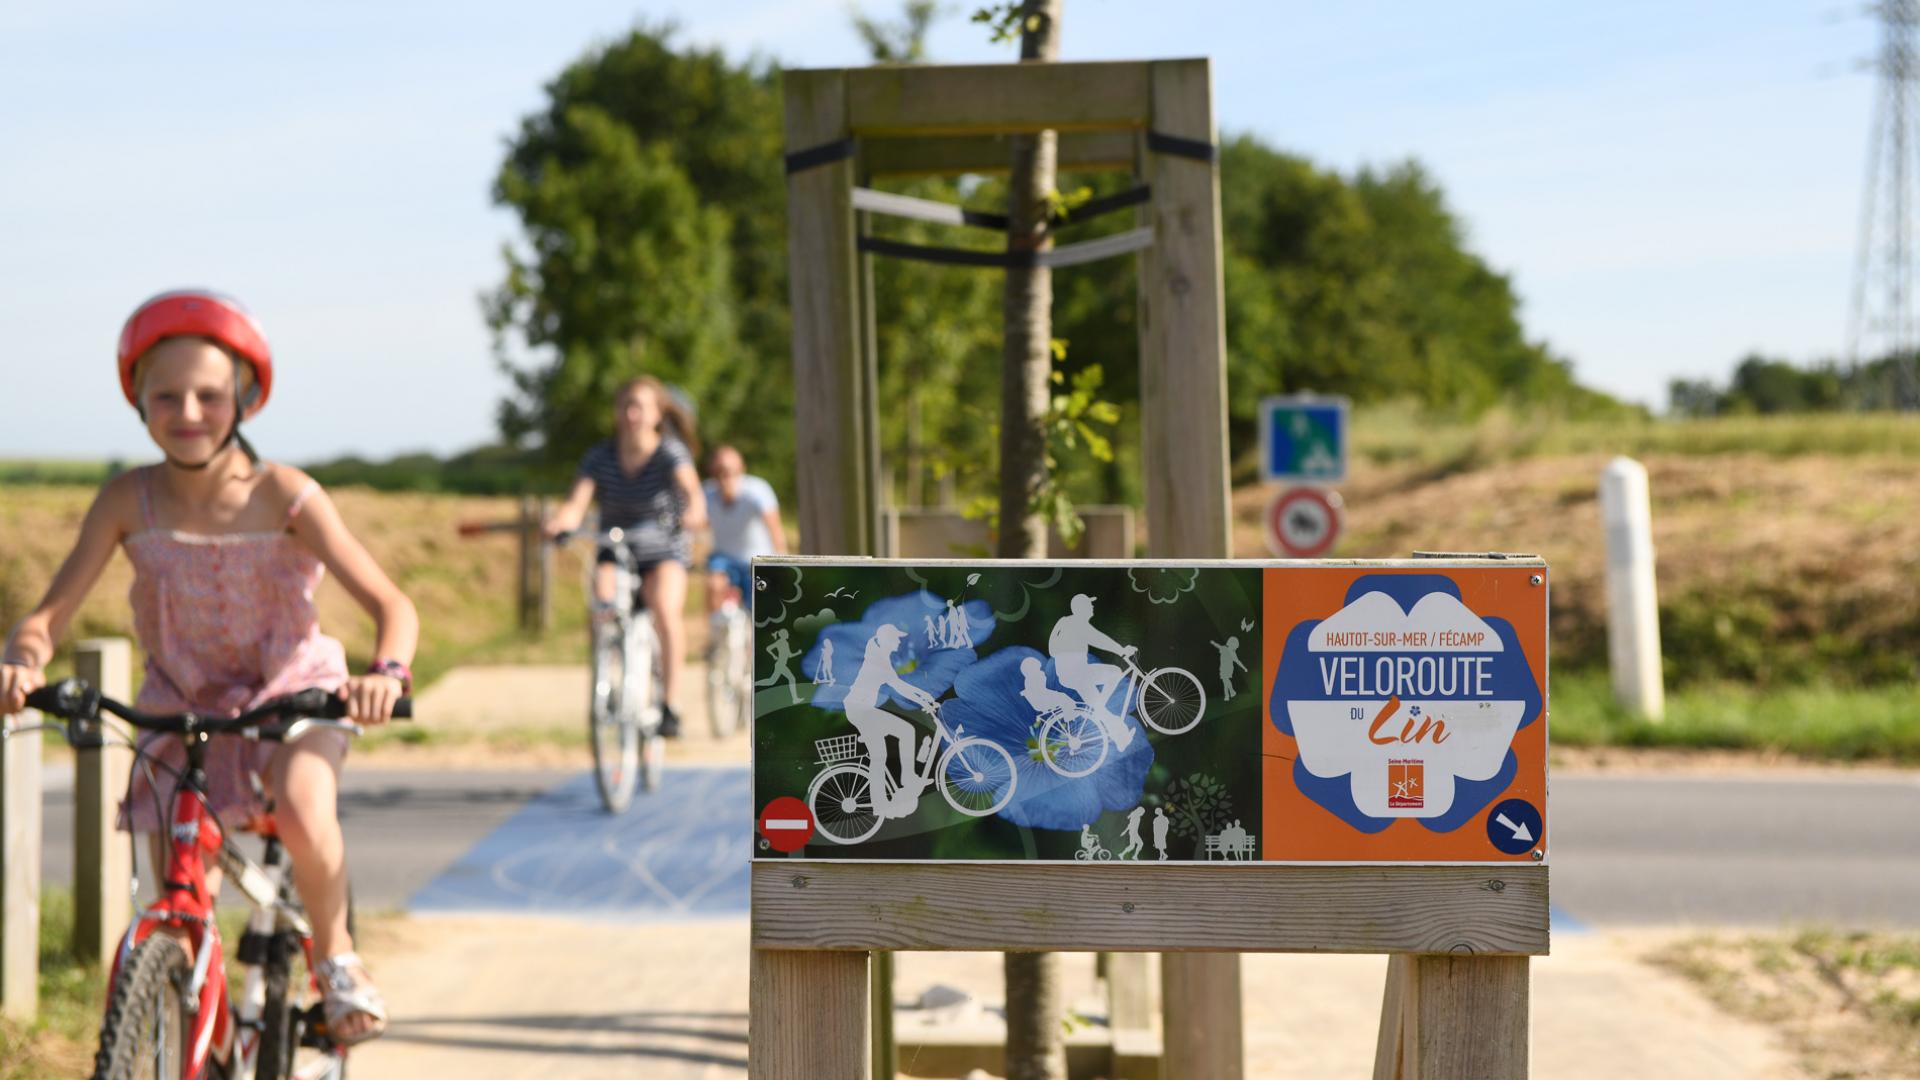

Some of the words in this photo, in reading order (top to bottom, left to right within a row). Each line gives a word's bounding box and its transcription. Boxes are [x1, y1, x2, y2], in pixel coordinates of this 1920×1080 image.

[1326, 631, 1427, 647] HAUTOT-SUR-MER
[1430, 631, 1436, 647] /
[1439, 629, 1485, 647] FÉCAMP
[1319, 656, 1494, 696] VELOROUTE
[1350, 707, 1364, 721] DU
[1368, 695, 1451, 745] Lin
